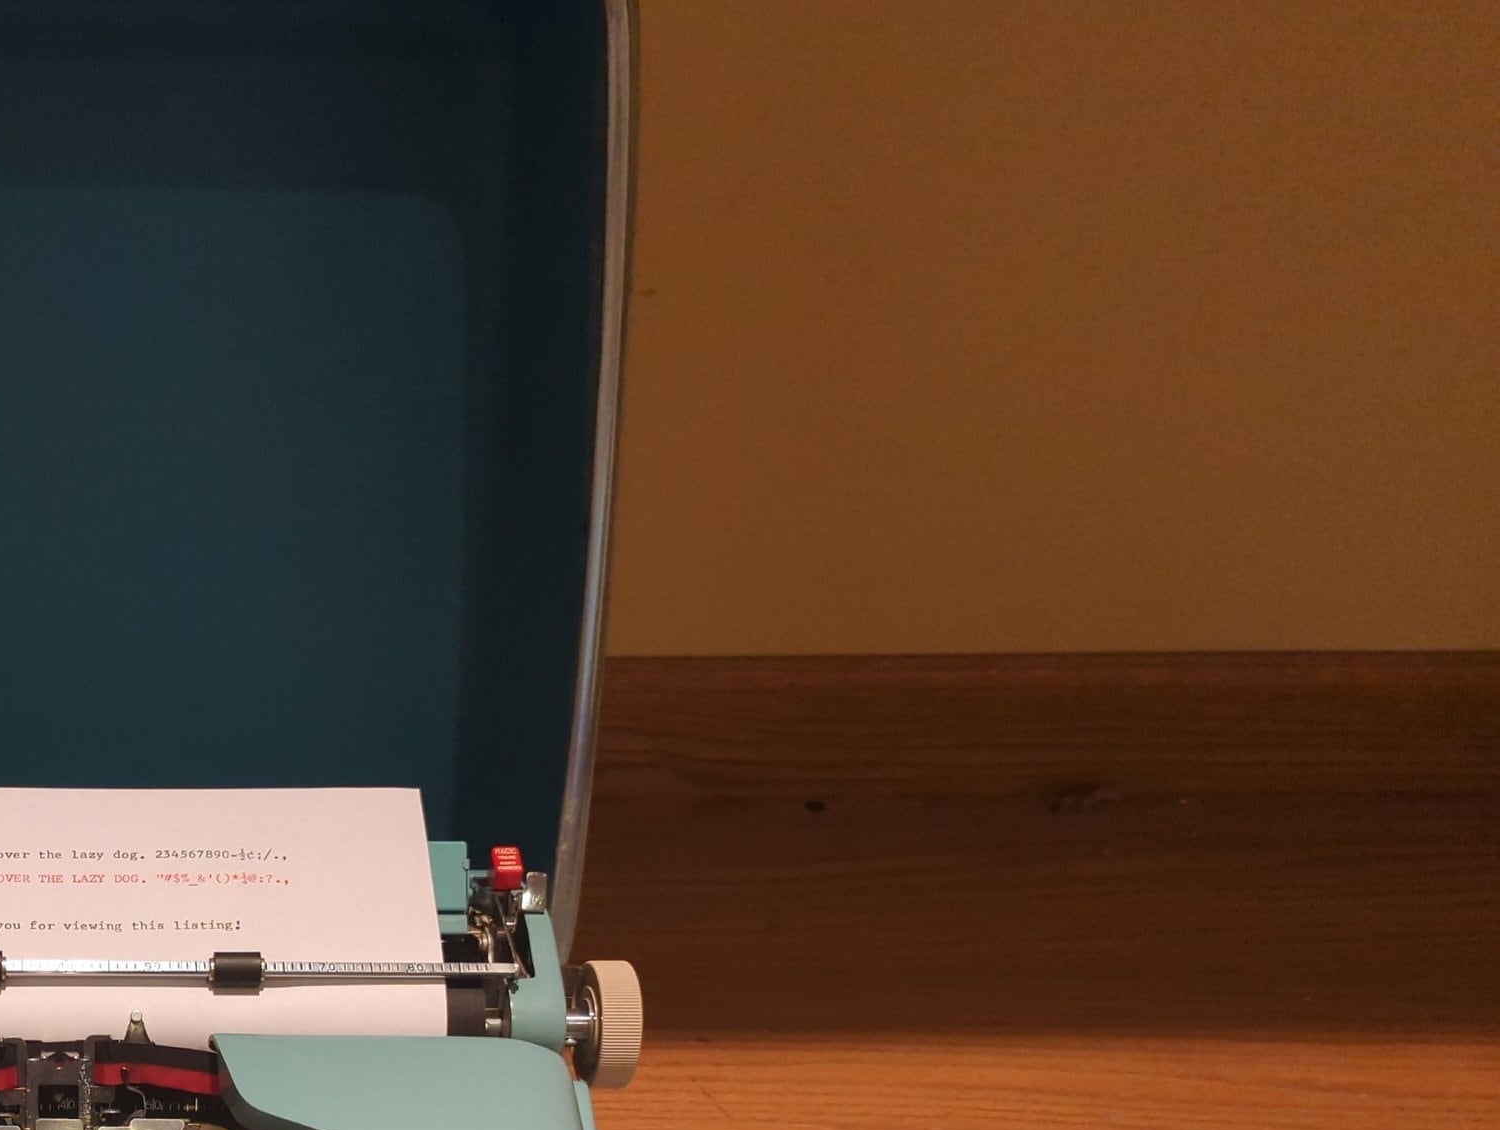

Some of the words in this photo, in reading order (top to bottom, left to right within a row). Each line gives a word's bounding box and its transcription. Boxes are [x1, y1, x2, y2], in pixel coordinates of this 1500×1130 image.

[39, 850, 62, 859] the
[72, 850, 104, 861] lazy
[113, 850, 146, 861] dog.
[38, 874, 63, 883] THE
[72, 874, 105, 883] LAZY
[114, 874, 147, 883] DOG.
[30, 920, 55, 930] for
[64, 920, 123, 932] viewing
[132, 920, 165, 930] this
[173, 920, 241, 932] listing!
